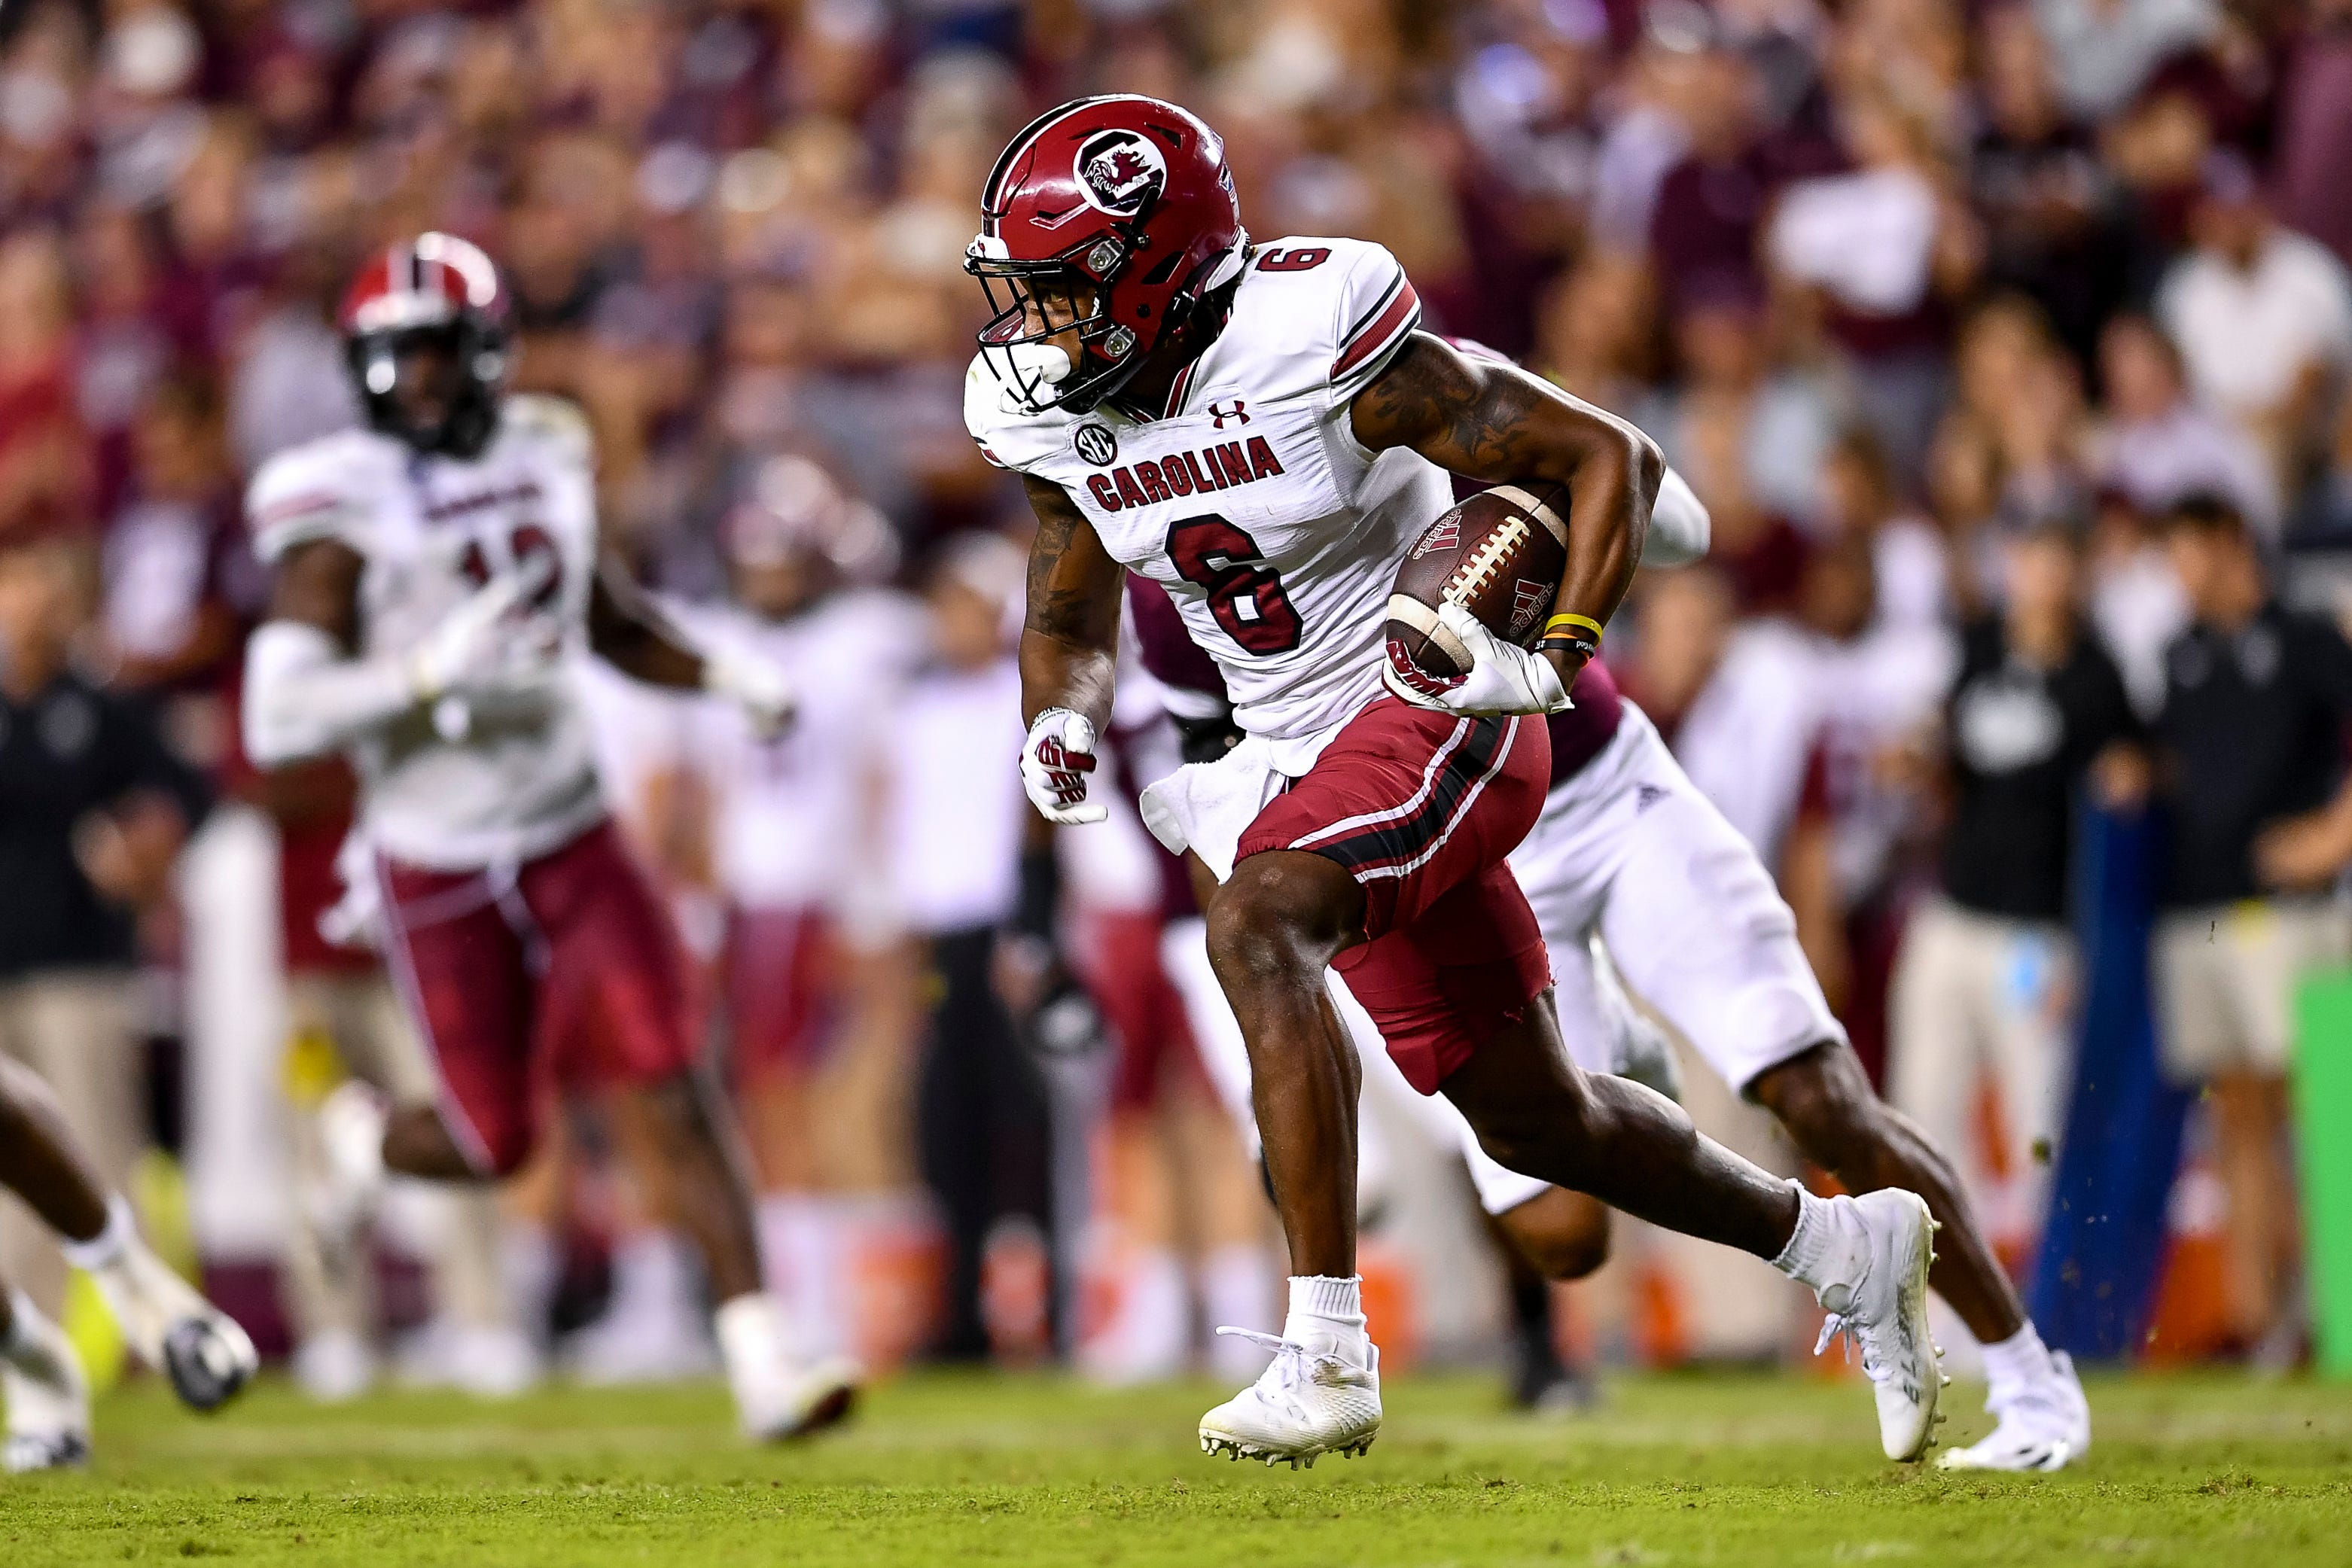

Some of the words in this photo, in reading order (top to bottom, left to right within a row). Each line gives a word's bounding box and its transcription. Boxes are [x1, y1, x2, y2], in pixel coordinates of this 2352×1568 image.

[1254, 247, 1332, 272] 6
[1077, 428, 1114, 464] SEC
[1086, 435, 1285, 513] CAROLINA
[1412, 509, 1461, 559] adidas
[1164, 513, 1304, 656] 6
[1510, 582, 1555, 636] adidas
